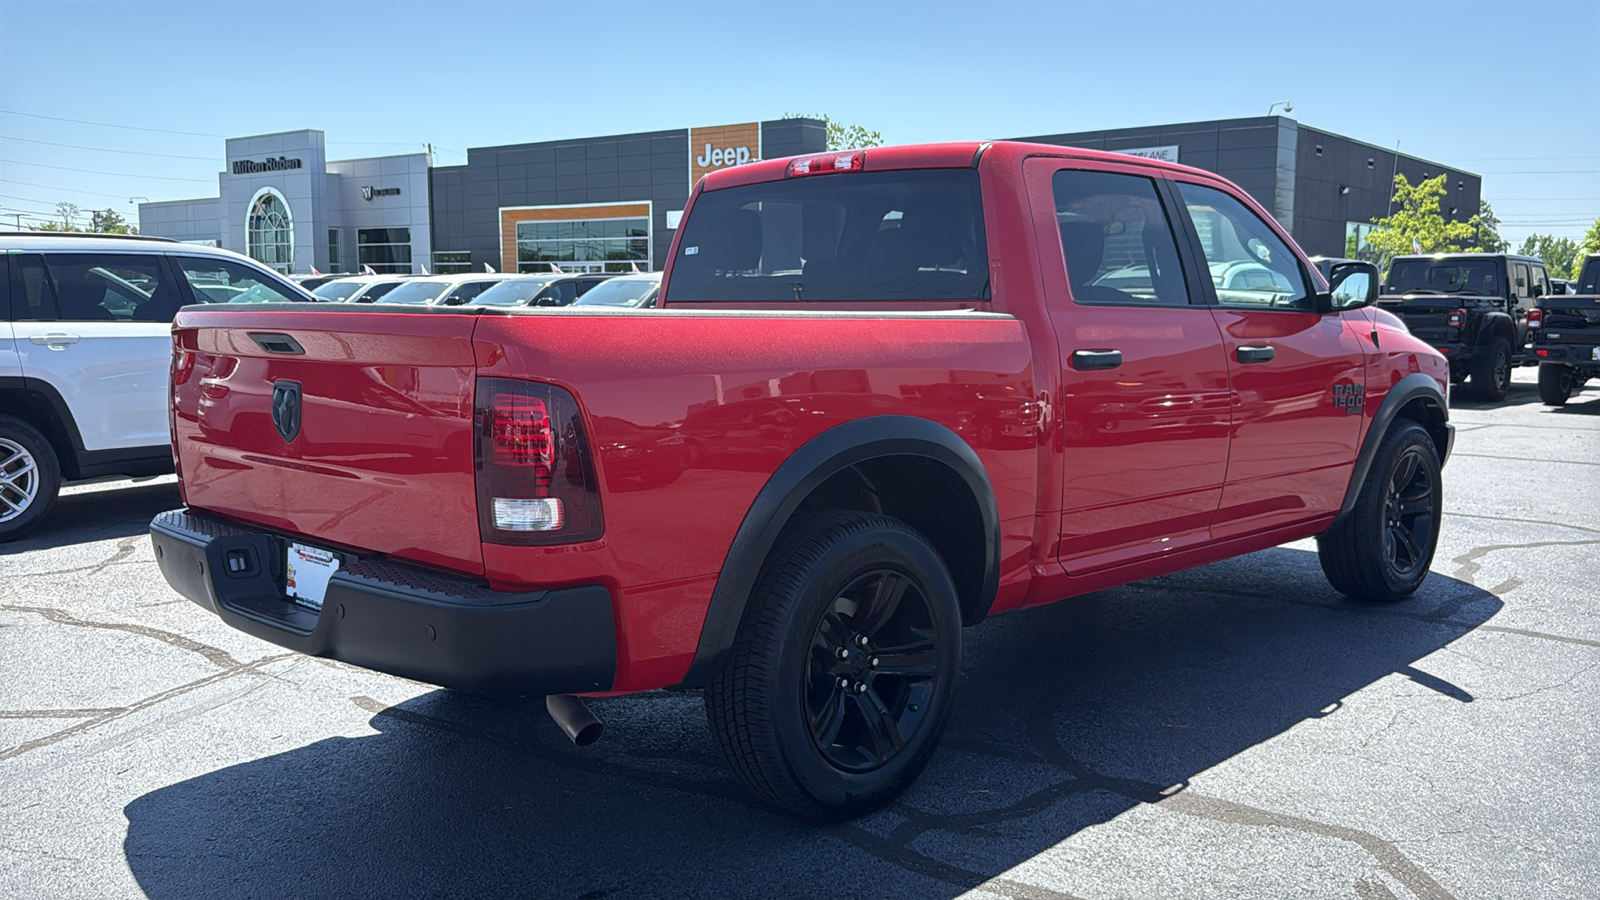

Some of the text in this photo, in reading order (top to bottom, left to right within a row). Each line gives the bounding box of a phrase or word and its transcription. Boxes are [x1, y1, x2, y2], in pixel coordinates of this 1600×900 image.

[697, 142, 750, 168] Jeep
[233, 156, 302, 175] Milton Ruben
[1333, 384, 1364, 395] RAM
[1333, 395, 1364, 408] 1500
